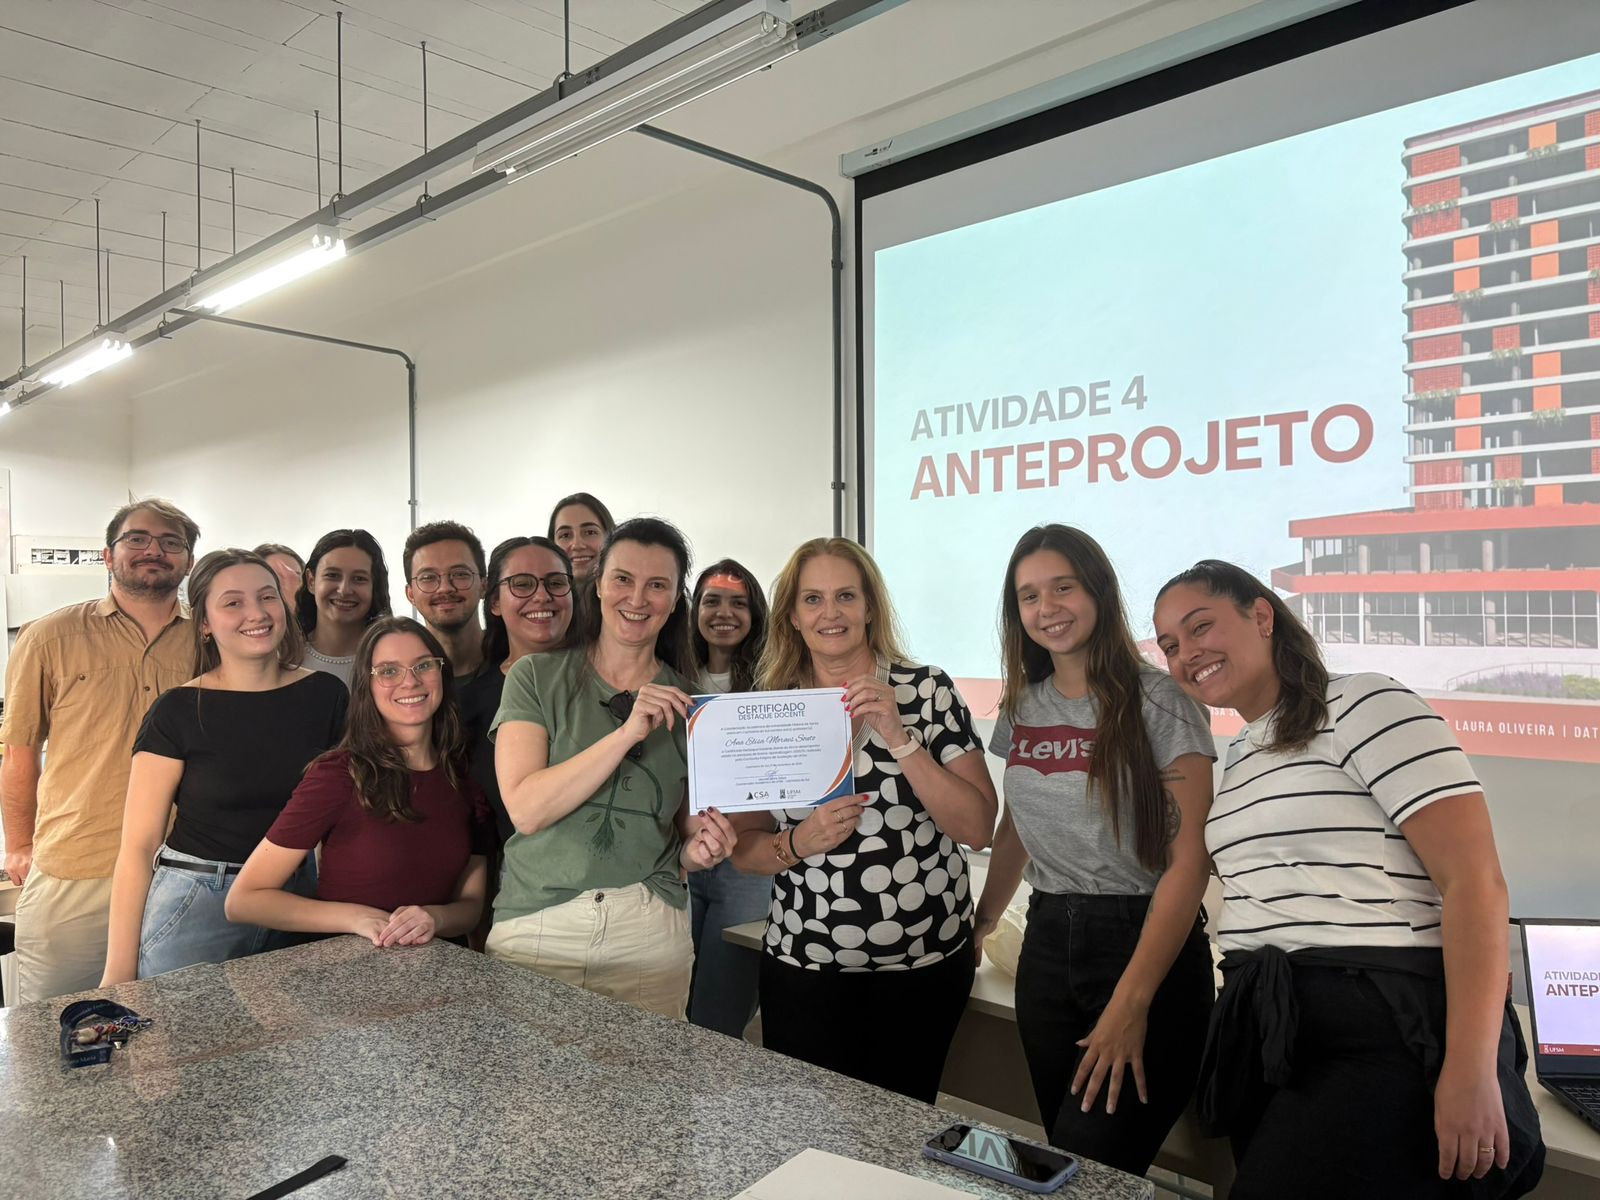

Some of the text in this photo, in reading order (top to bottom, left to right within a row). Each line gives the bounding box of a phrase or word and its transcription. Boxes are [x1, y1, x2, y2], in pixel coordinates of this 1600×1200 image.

[910, 375, 1148, 441] ATIVIDADE 4
[910, 404, 1374, 500] ANTEPROJETO
[738, 702, 805, 714] CERTIFICADO
[1456, 720, 1493, 733] LAURA
[1499, 722, 1555, 736] OLIVEIRA
[1574, 726, 1598, 738] DAT
[1544, 971, 1600, 981] ATIVIDAD
